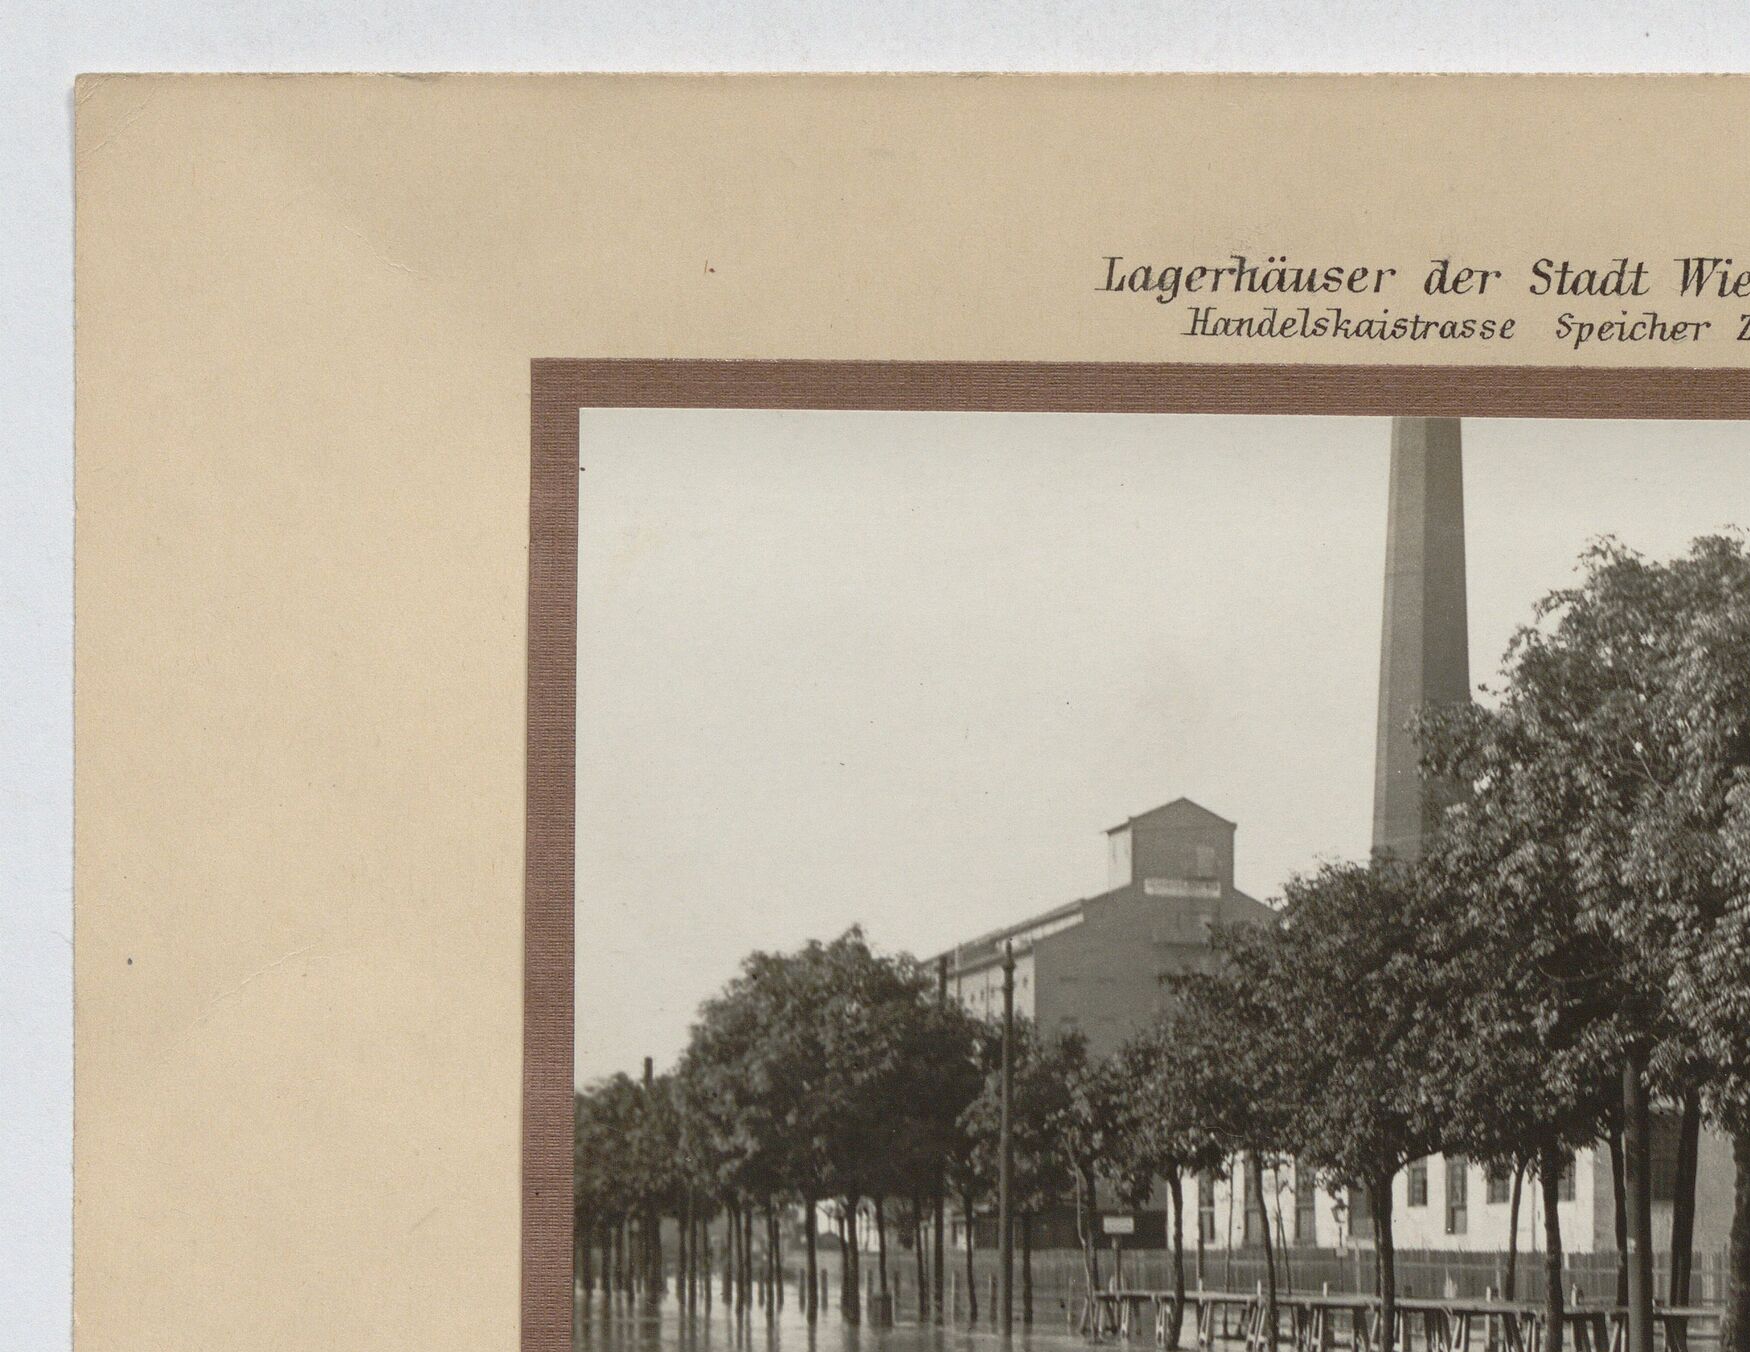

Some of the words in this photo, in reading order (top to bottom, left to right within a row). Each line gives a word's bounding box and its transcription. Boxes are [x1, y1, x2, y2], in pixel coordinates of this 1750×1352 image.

[1094, 254, 1397, 304] Lagerhäuser
[1423, 259, 1502, 296] der
[1529, 257, 1650, 297] Stadt
[1180, 306, 1516, 341] Handelskaistrasse
[1555, 309, 1712, 350] Speicher
